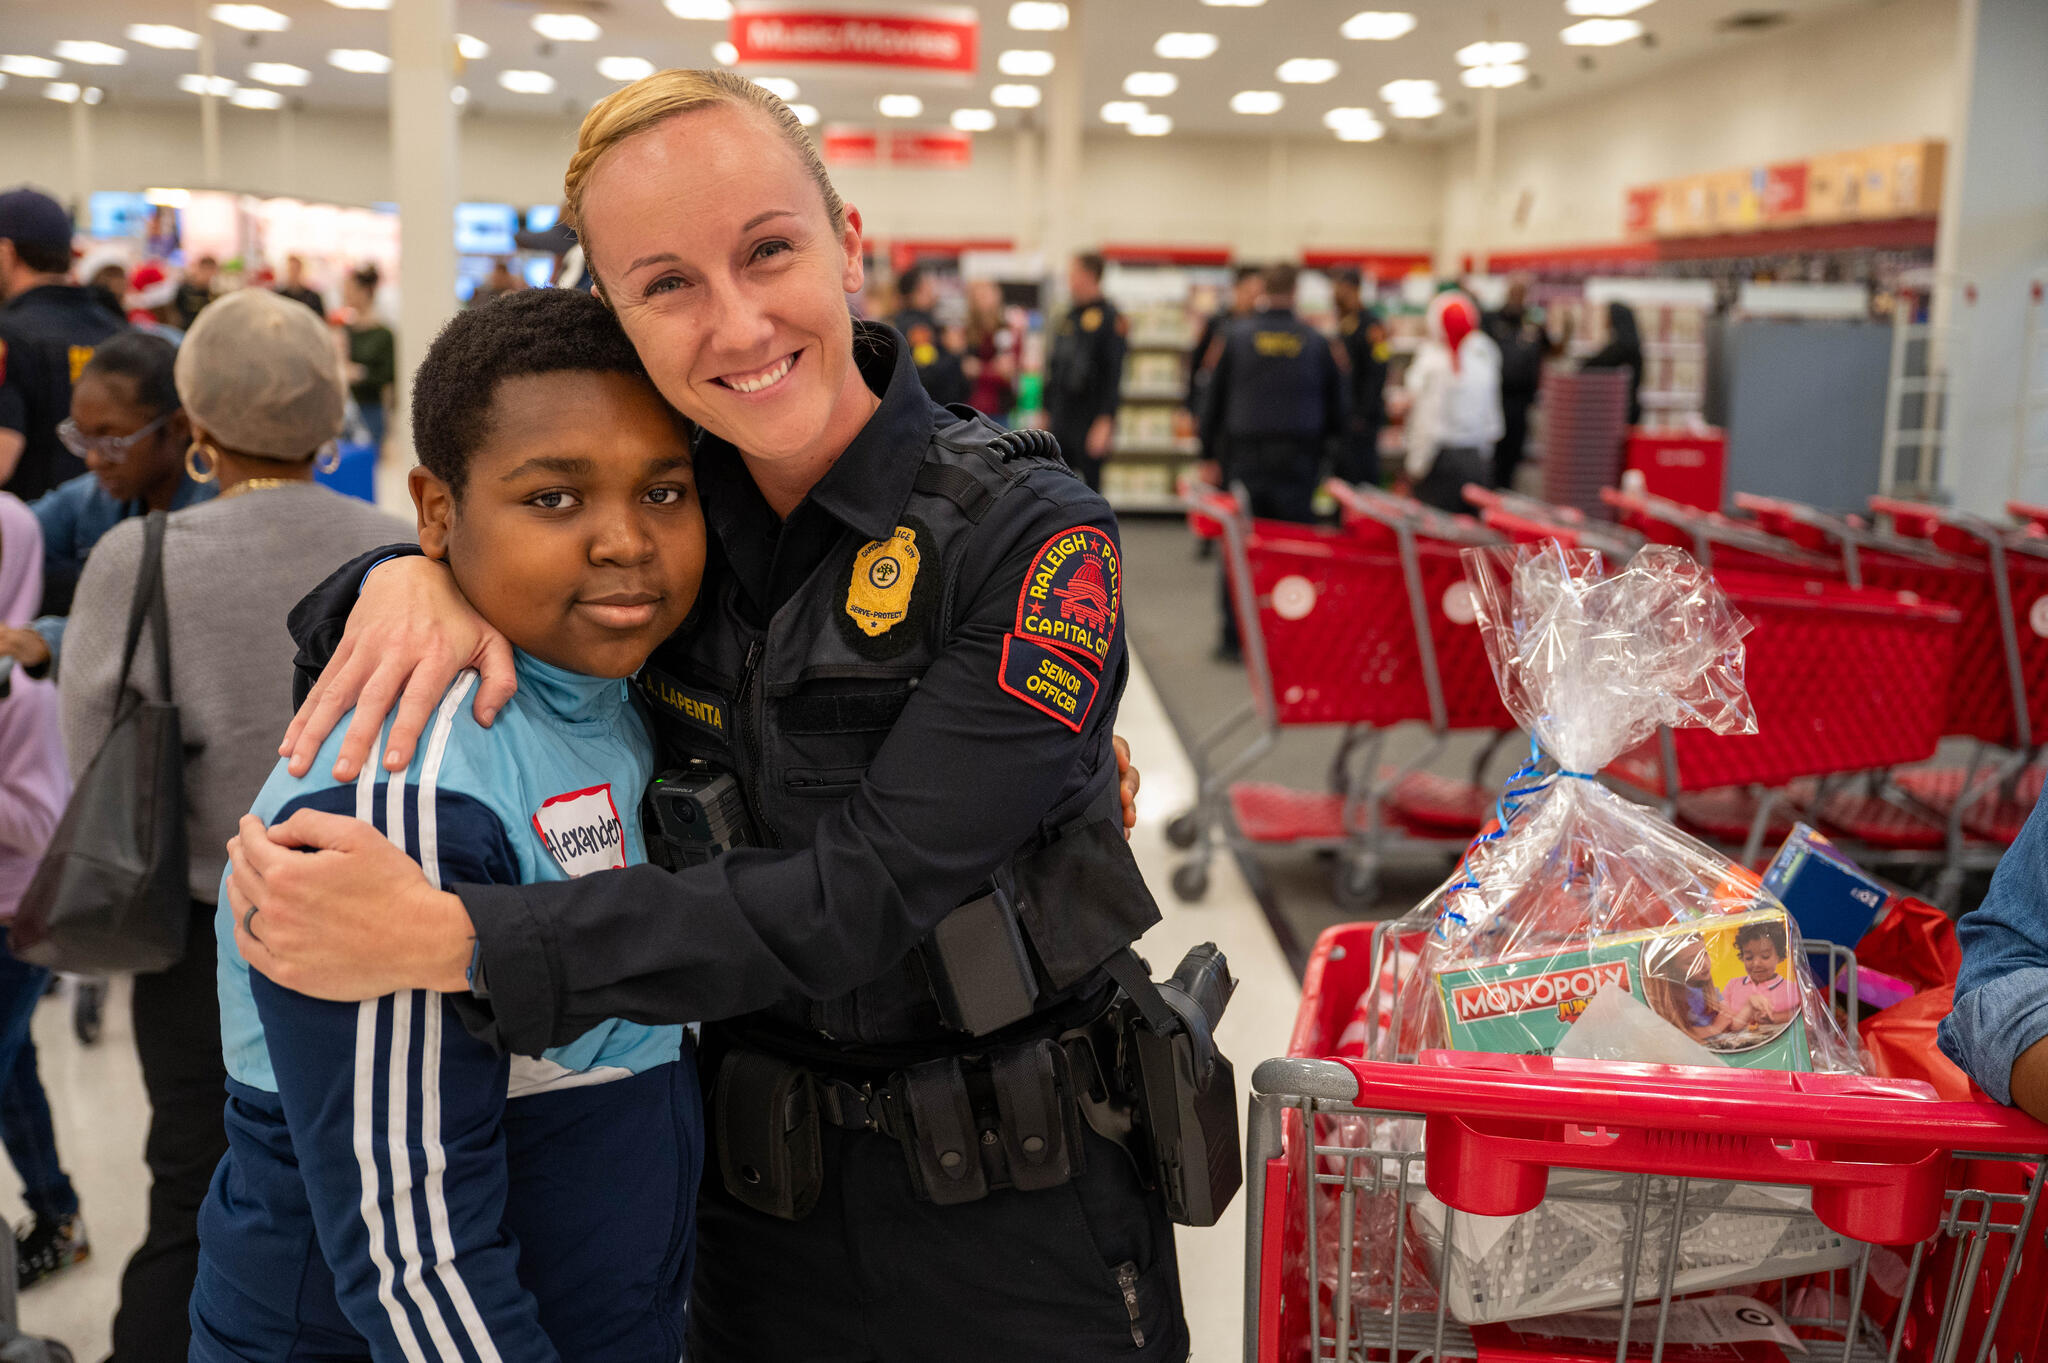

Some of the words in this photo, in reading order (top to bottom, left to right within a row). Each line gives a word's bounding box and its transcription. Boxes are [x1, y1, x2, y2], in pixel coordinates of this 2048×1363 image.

[1029, 533, 1088, 600] RALEIGH
[850, 605, 903, 620] SERVE-PROTECT
[1025, 615, 1094, 650] CAPITAL
[1026, 675, 1078, 715] OFFICER
[1038, 659, 1082, 696] SENIOR
[661, 682, 723, 730] LAPENTA
[543, 815, 623, 862] Alexander
[1461, 966, 1623, 1018] MONOPOLY
